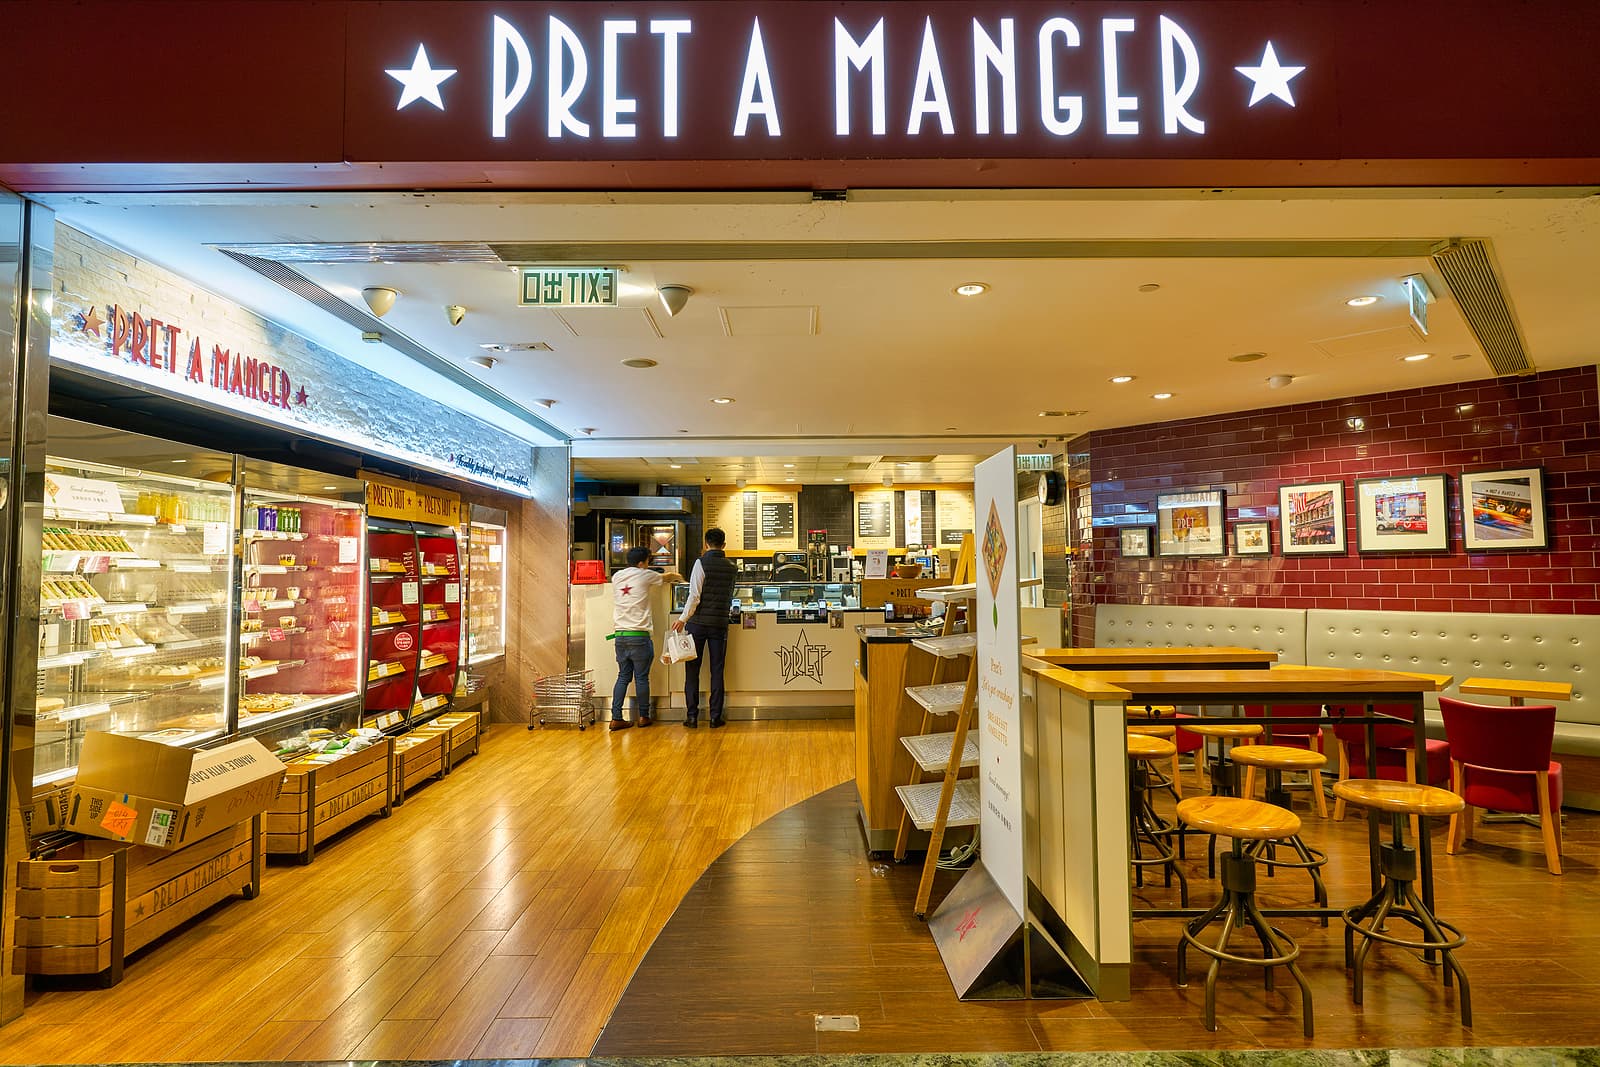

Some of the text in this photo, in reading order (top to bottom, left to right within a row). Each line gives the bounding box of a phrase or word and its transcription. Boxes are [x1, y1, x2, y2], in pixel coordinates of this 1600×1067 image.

[491, 14, 1206, 138] PRET A MANGER
[112, 303, 291, 411] PRET A MANGER
[896, 588, 911, 598] PRET
[780, 645, 826, 676] PRET
[205, 763, 230, 777] WITH
[225, 754, 257, 770] HANDLE
[329, 795, 345, 817] PRET
[351, 781, 374, 807] MANGER
[153, 854, 232, 913] PRET A MANGER
